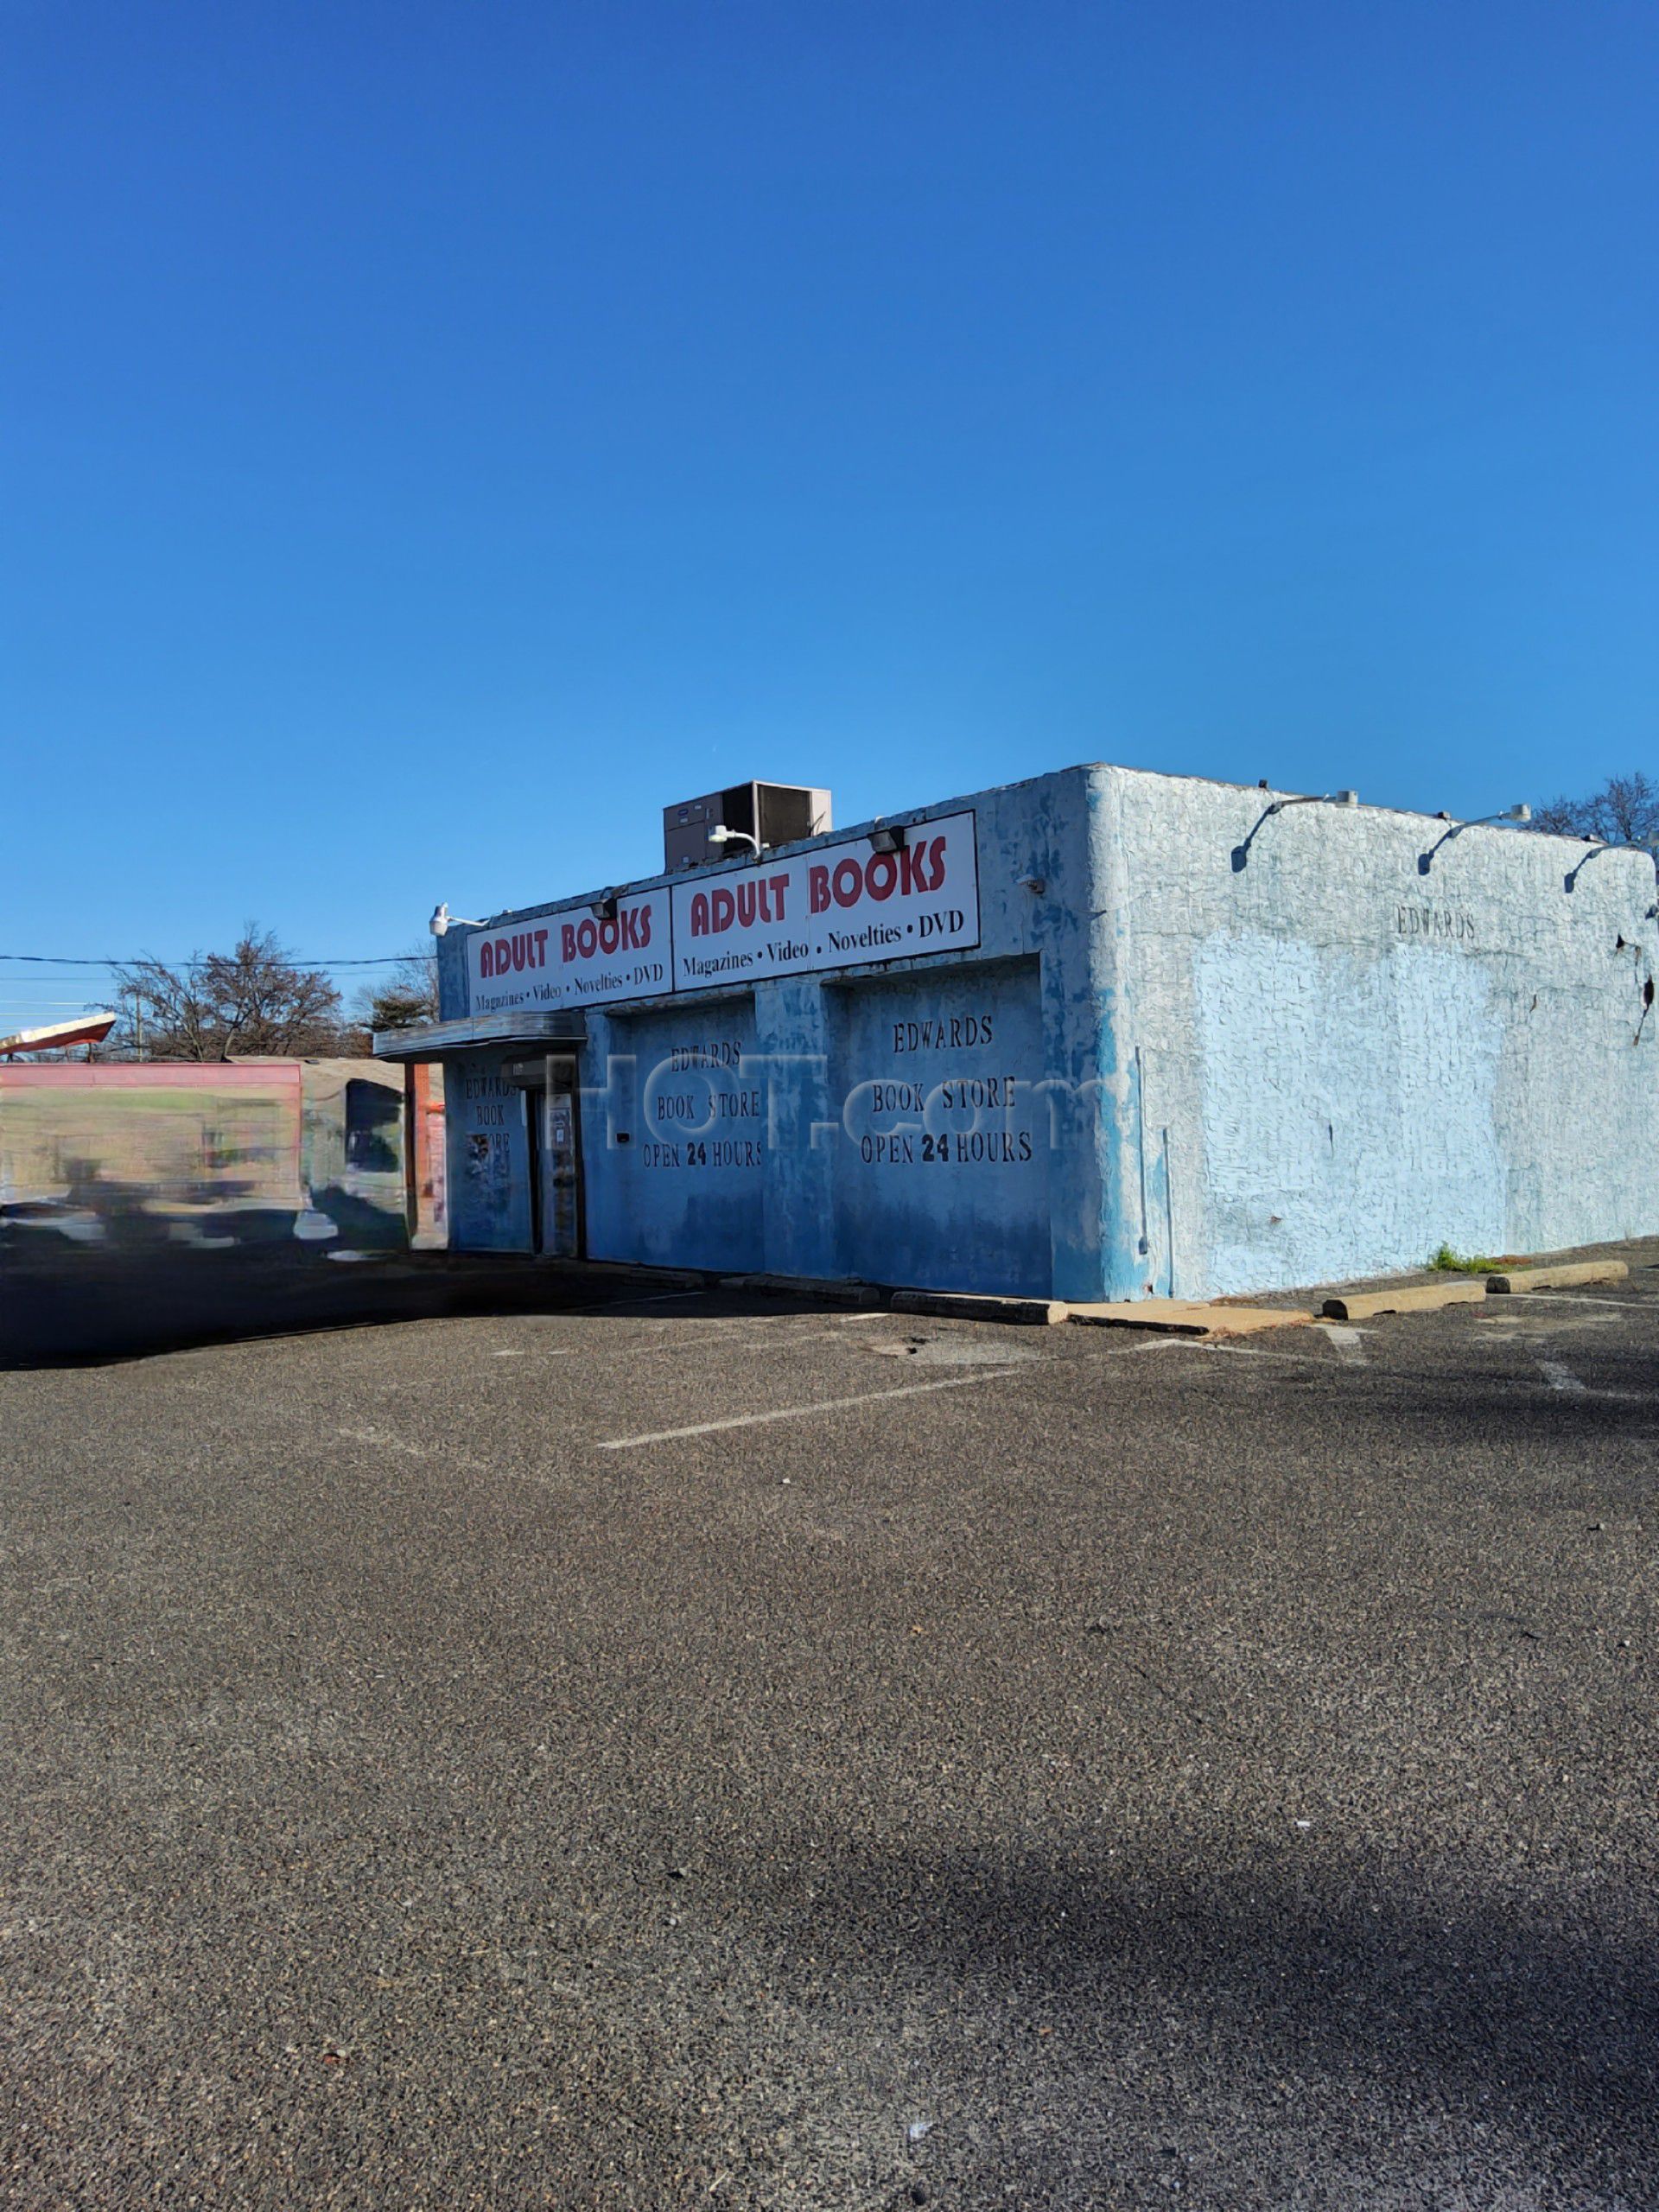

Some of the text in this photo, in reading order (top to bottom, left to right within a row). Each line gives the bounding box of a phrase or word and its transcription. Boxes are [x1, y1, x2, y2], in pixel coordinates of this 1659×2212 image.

[691, 836, 947, 937] ADULT BOOKS
[1397, 905, 1475, 939] EDWARDS
[480, 905, 652, 978] ADULT BOOKS
[683, 910, 964, 978] Magazines Video Novelties DVD
[476, 963, 664, 1013] Magazines Video Novelties DVD
[893, 1015, 993, 1053] EDWARDS
[671, 1041, 741, 1072] EDWARDS
[658, 1091, 760, 1120] BOOK STORE
[873, 1076, 1015, 1113] BOOK STORE
[476, 1105, 505, 1127] BOOK
[643, 1141, 761, 1167] OPEN 24 HOURS
[861, 1131, 1032, 1163] OPEN 24 HOURS
